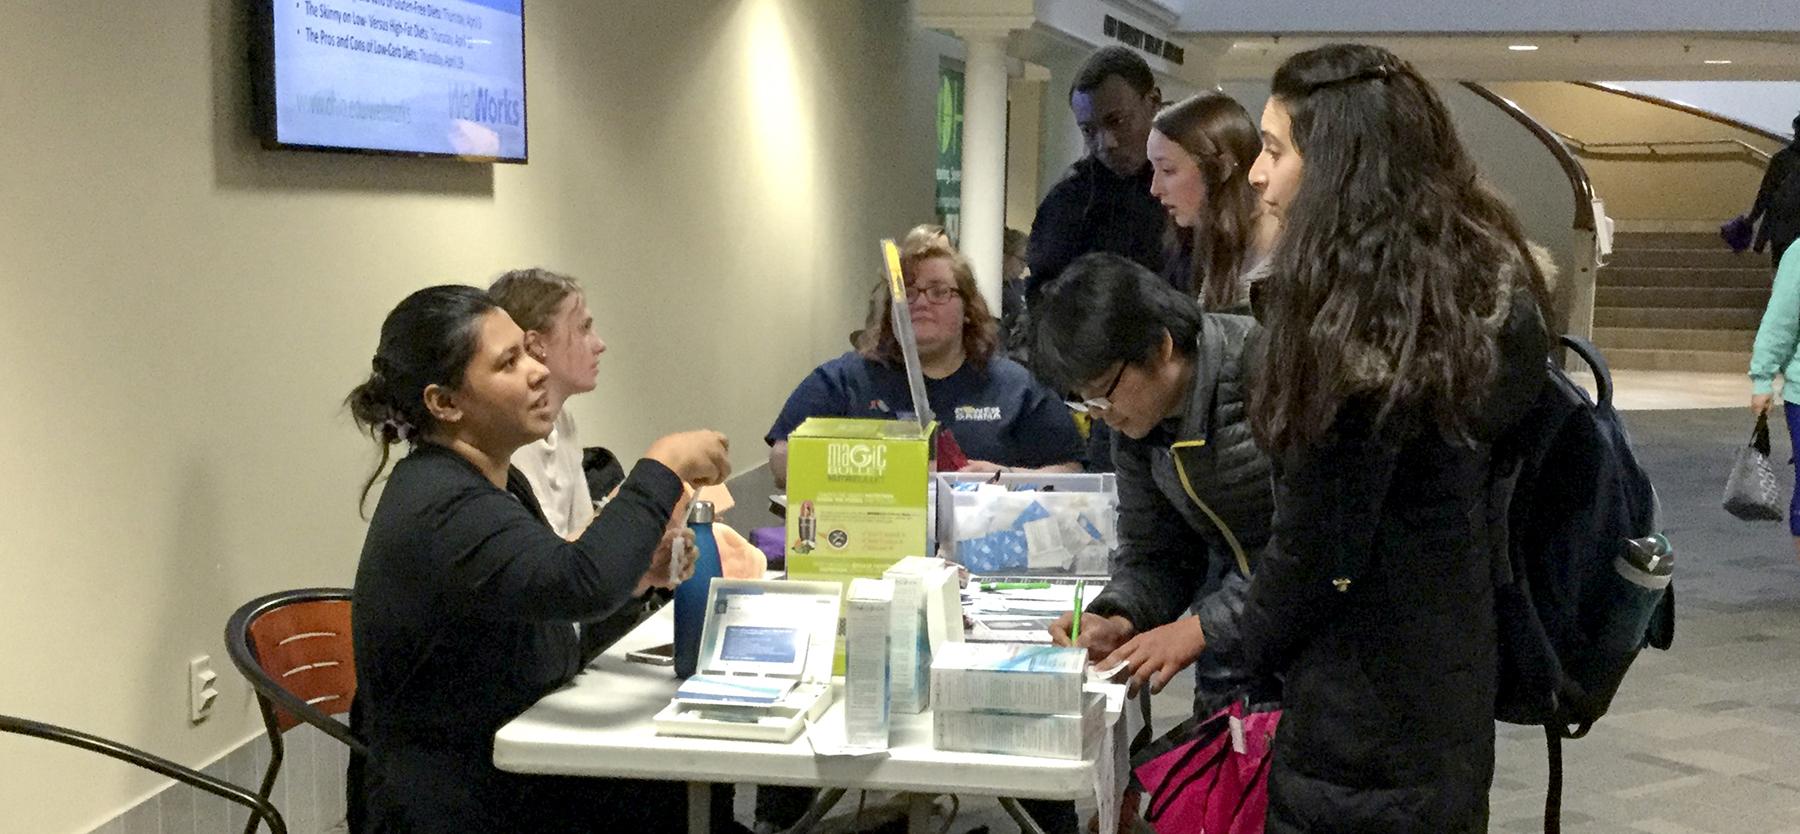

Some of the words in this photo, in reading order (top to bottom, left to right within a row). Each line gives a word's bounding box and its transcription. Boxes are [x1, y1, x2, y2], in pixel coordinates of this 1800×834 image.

[305, 0, 317, 17] The
[320, 3, 341, 24] Skinny
[343, 12, 351, 23] on
[369, 15, 388, 31] Versus
[390, 20, 413, 37] High-Fat
[305, 27, 318, 44] The
[320, 29, 335, 46] Pros
[335, 33, 348, 49] and
[350, 35, 365, 52] Cons
[374, 39, 402, 58] Low-Carb
